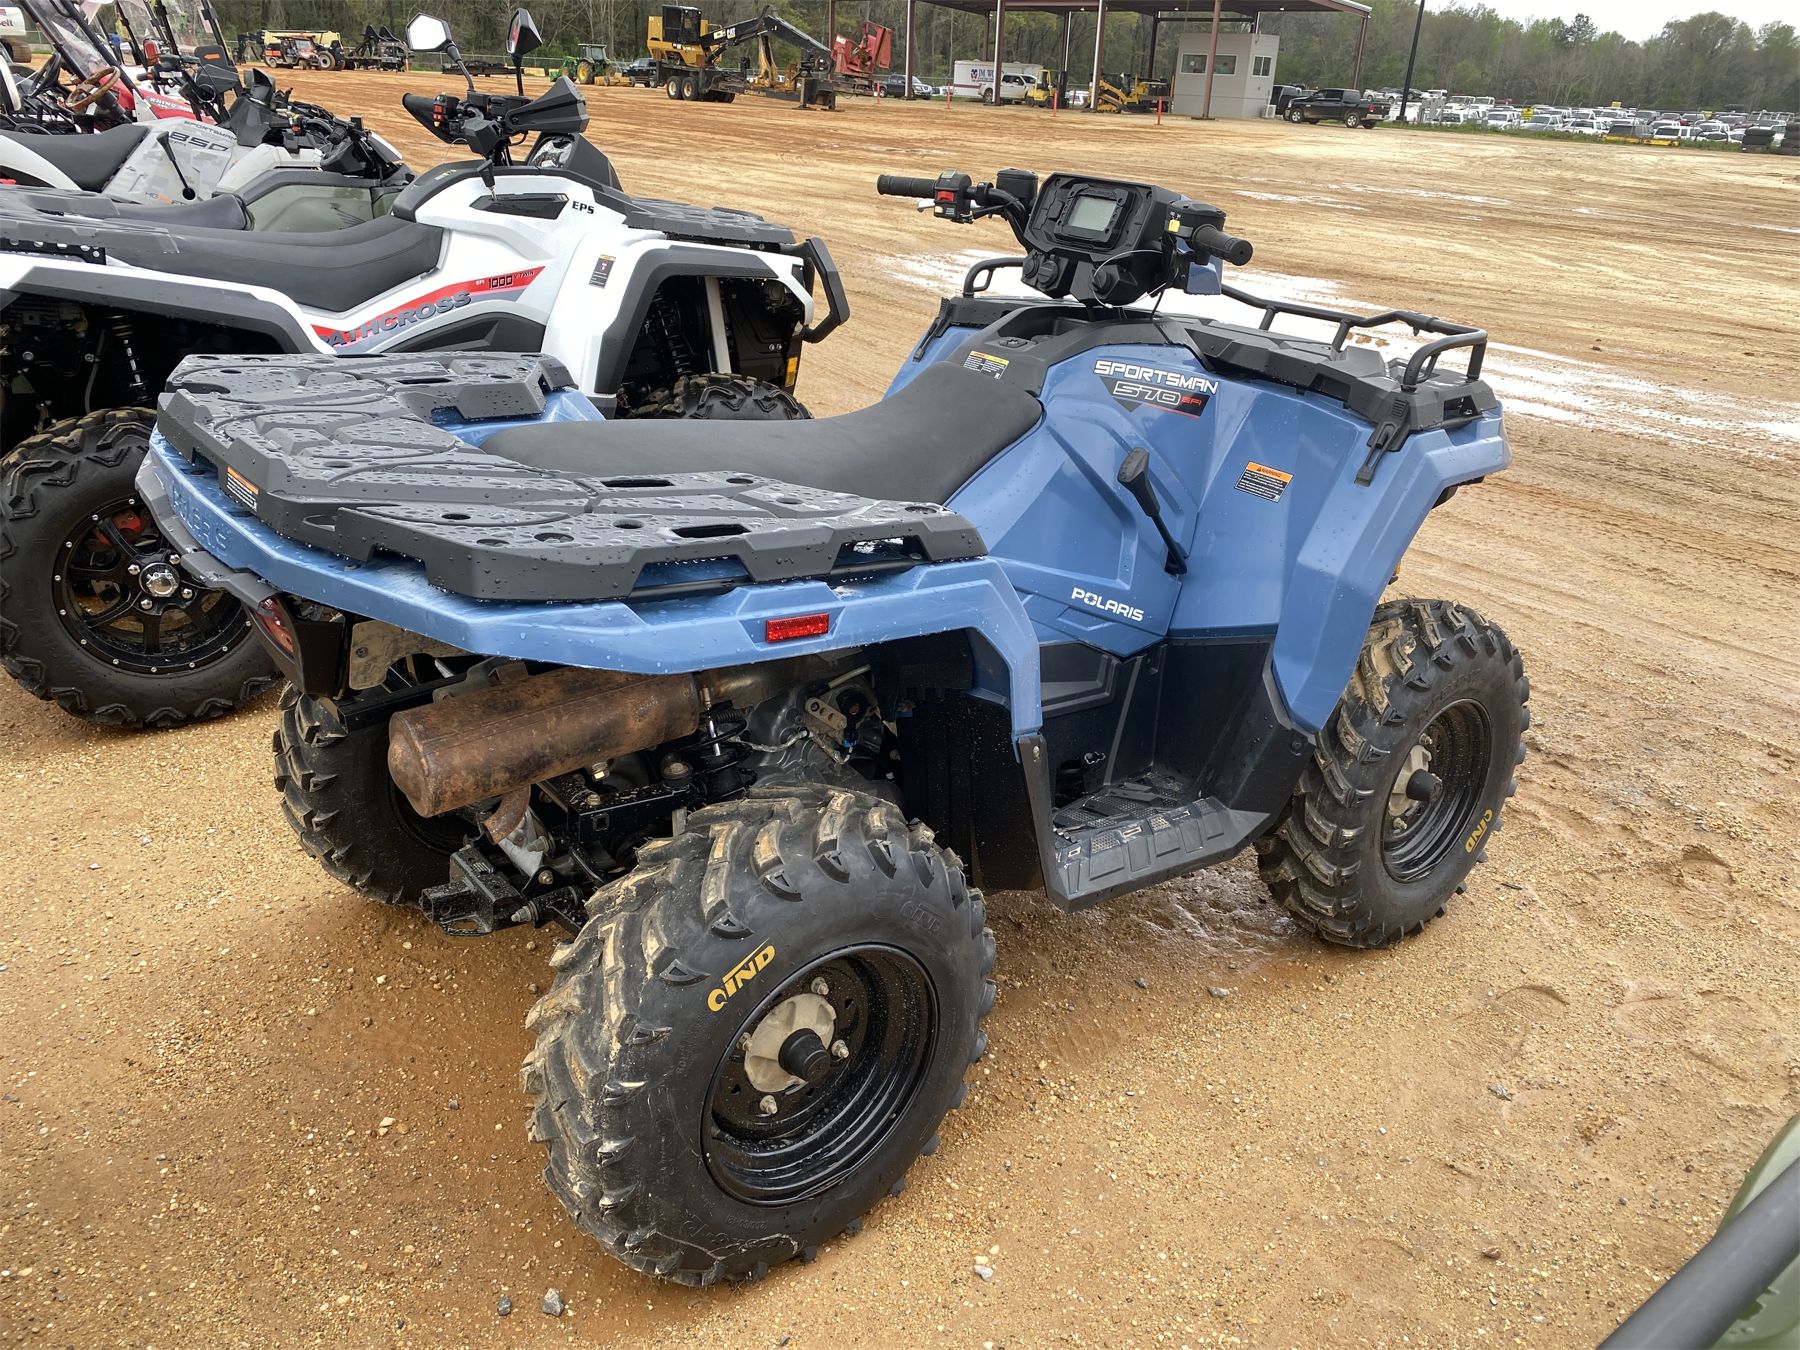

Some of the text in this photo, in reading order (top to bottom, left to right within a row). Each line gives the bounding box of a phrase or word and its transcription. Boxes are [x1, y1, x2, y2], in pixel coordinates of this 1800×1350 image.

[183, 120, 238, 140] SPORTSMAN
[169, 131, 229, 152] 850
[571, 200, 595, 215] EPS
[488, 275, 513, 288] 1000
[1094, 360, 1219, 395] SPORTSMAN
[1113, 381, 1181, 406] 570
[1261, 468, 1282, 478] WARNING
[1071, 587, 1144, 622] POLARIS
